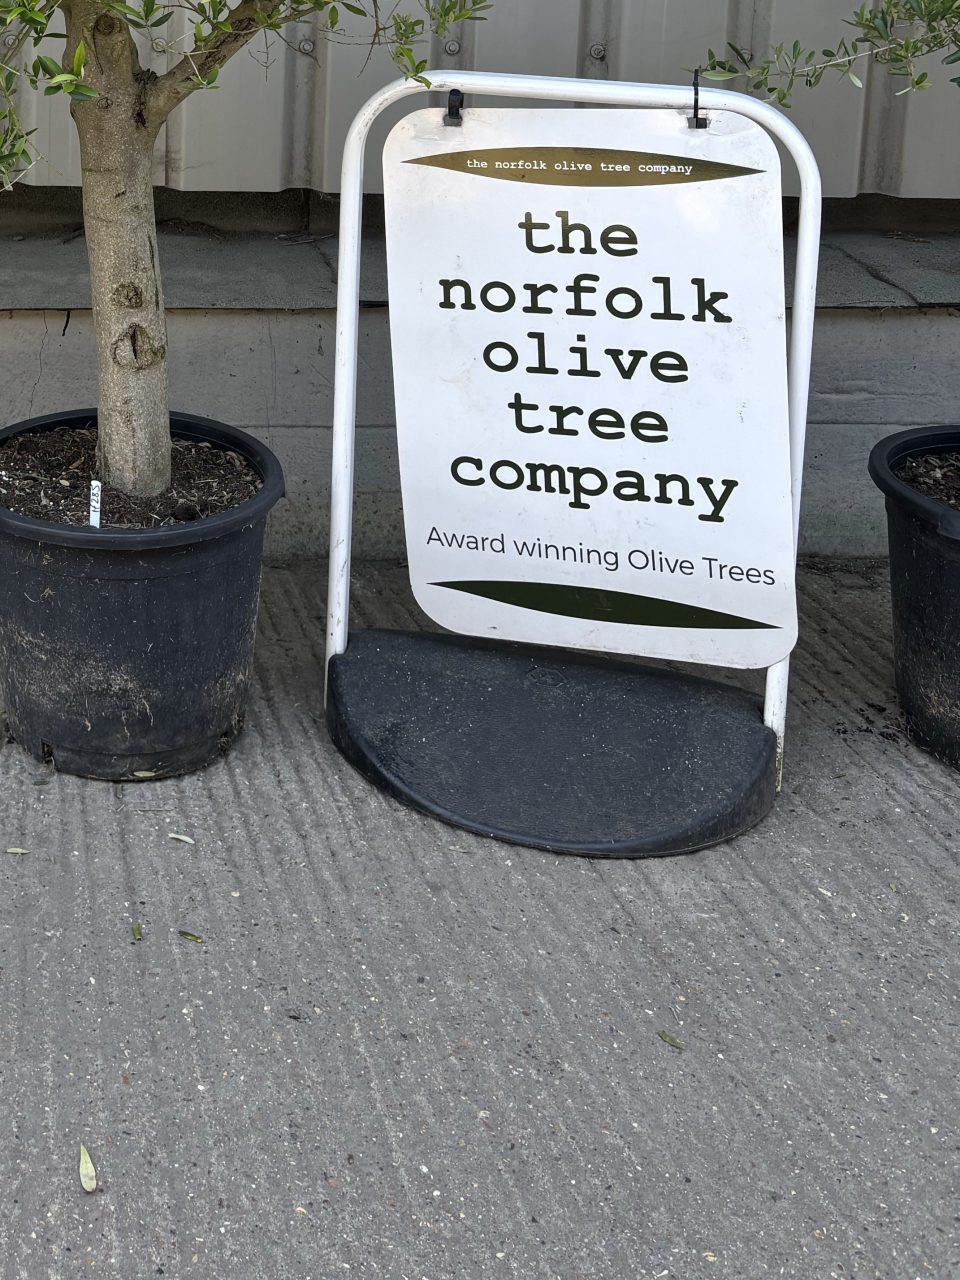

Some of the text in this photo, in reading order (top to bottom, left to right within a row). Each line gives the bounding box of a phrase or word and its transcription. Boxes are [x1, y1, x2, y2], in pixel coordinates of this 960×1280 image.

[466, 158, 693, 176] the norfolk olive tree company
[517, 210, 639, 257] the
[438, 273, 733, 324] norfolk
[482, 331, 689, 384] olive
[507, 392, 669, 444] tree
[450, 455, 739, 523] company
[426, 526, 776, 586] Award winning Olive Trees
